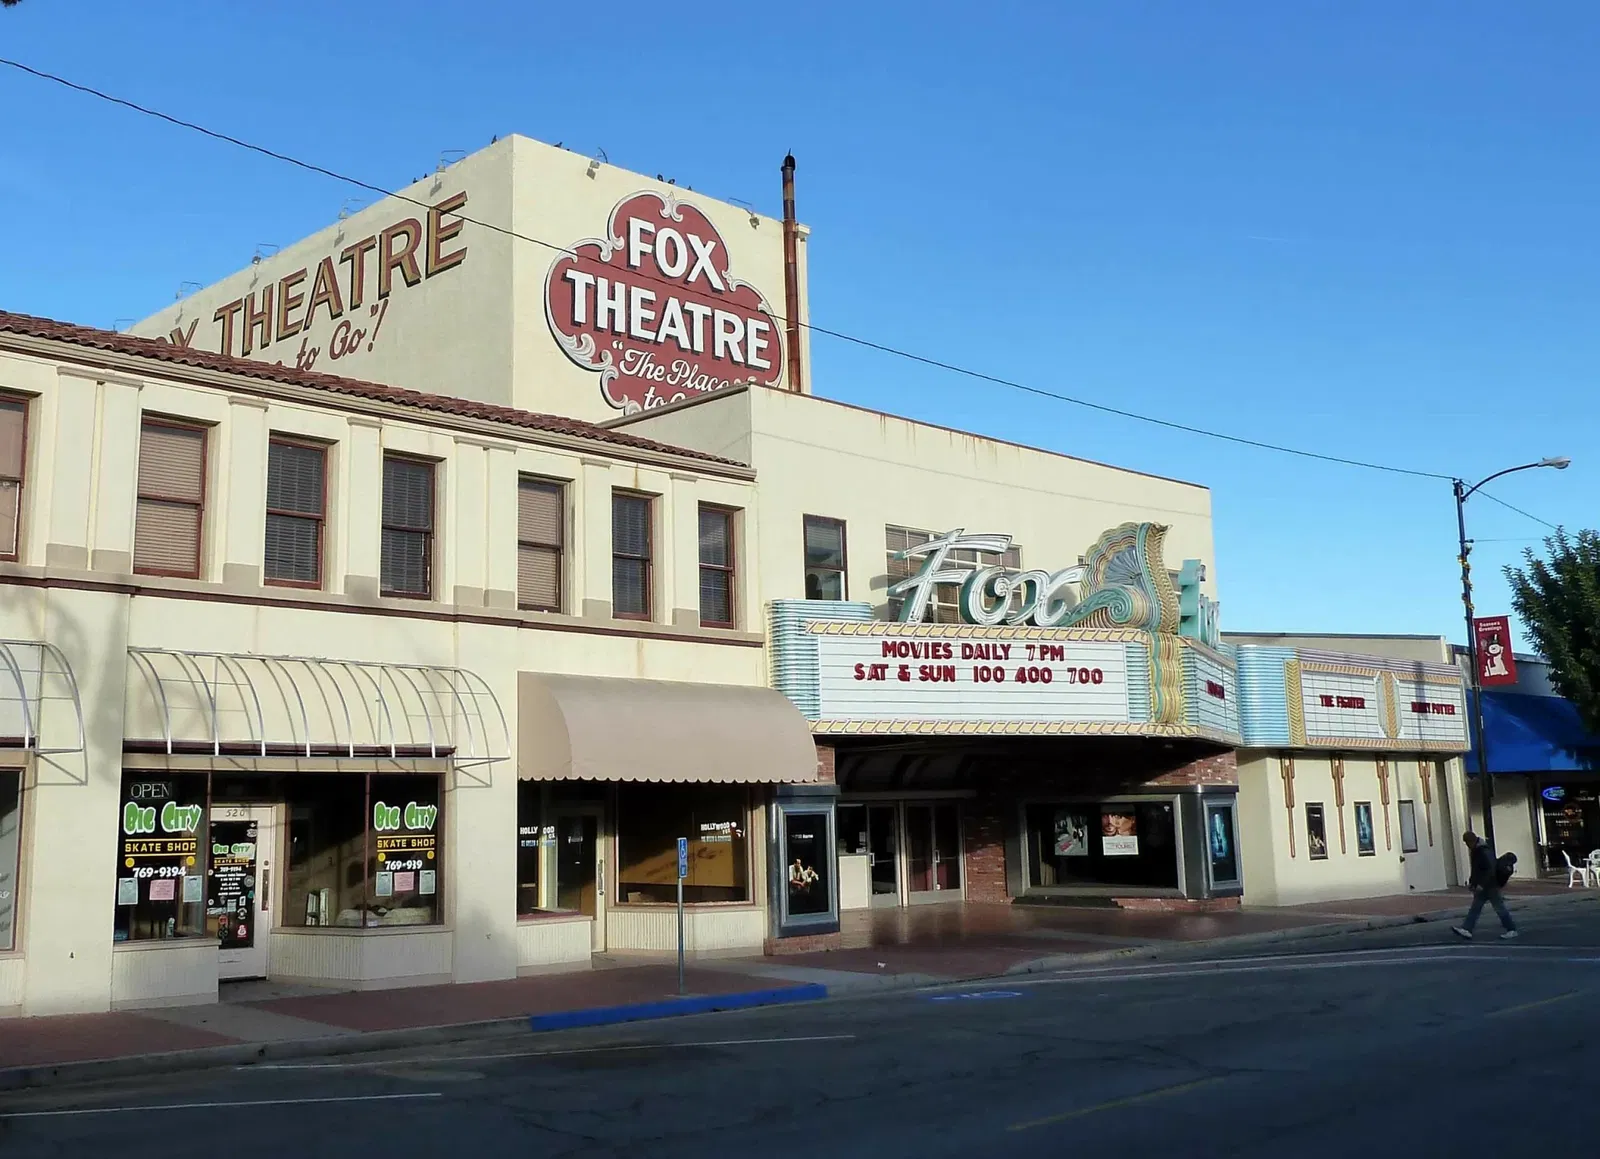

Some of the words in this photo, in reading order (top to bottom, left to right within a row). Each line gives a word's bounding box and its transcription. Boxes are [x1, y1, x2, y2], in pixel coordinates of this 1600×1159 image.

[628, 216, 726, 292] FOX
[213, 190, 468, 357] THEATRE
[562, 268, 771, 370] THEATRE
[296, 337, 321, 371] to
[881, 640, 953, 659] MOVIES
[960, 642, 1012, 661] DAILY
[853, 663, 888, 681] SAT
[897, 664, 911, 682] &
[918, 664, 956, 682] SUN
[973, 665, 1005, 683] 100
[1014, 666, 1053, 684] 400
[1066, 667, 1104, 685] 700
[130, 783, 170, 798] OPEN
[161, 801, 202, 833] CITY
[225, 808, 246, 818] 520
[404, 801, 438, 831] CITY
[124, 843, 161, 853] SKATE
[167, 842, 197, 852] SHOP
[377, 839, 407, 848] SKATE
[411, 838, 435, 847] SHOP
[132, 866, 187, 878] 769-9394
[385, 860, 422, 870] 769-939
